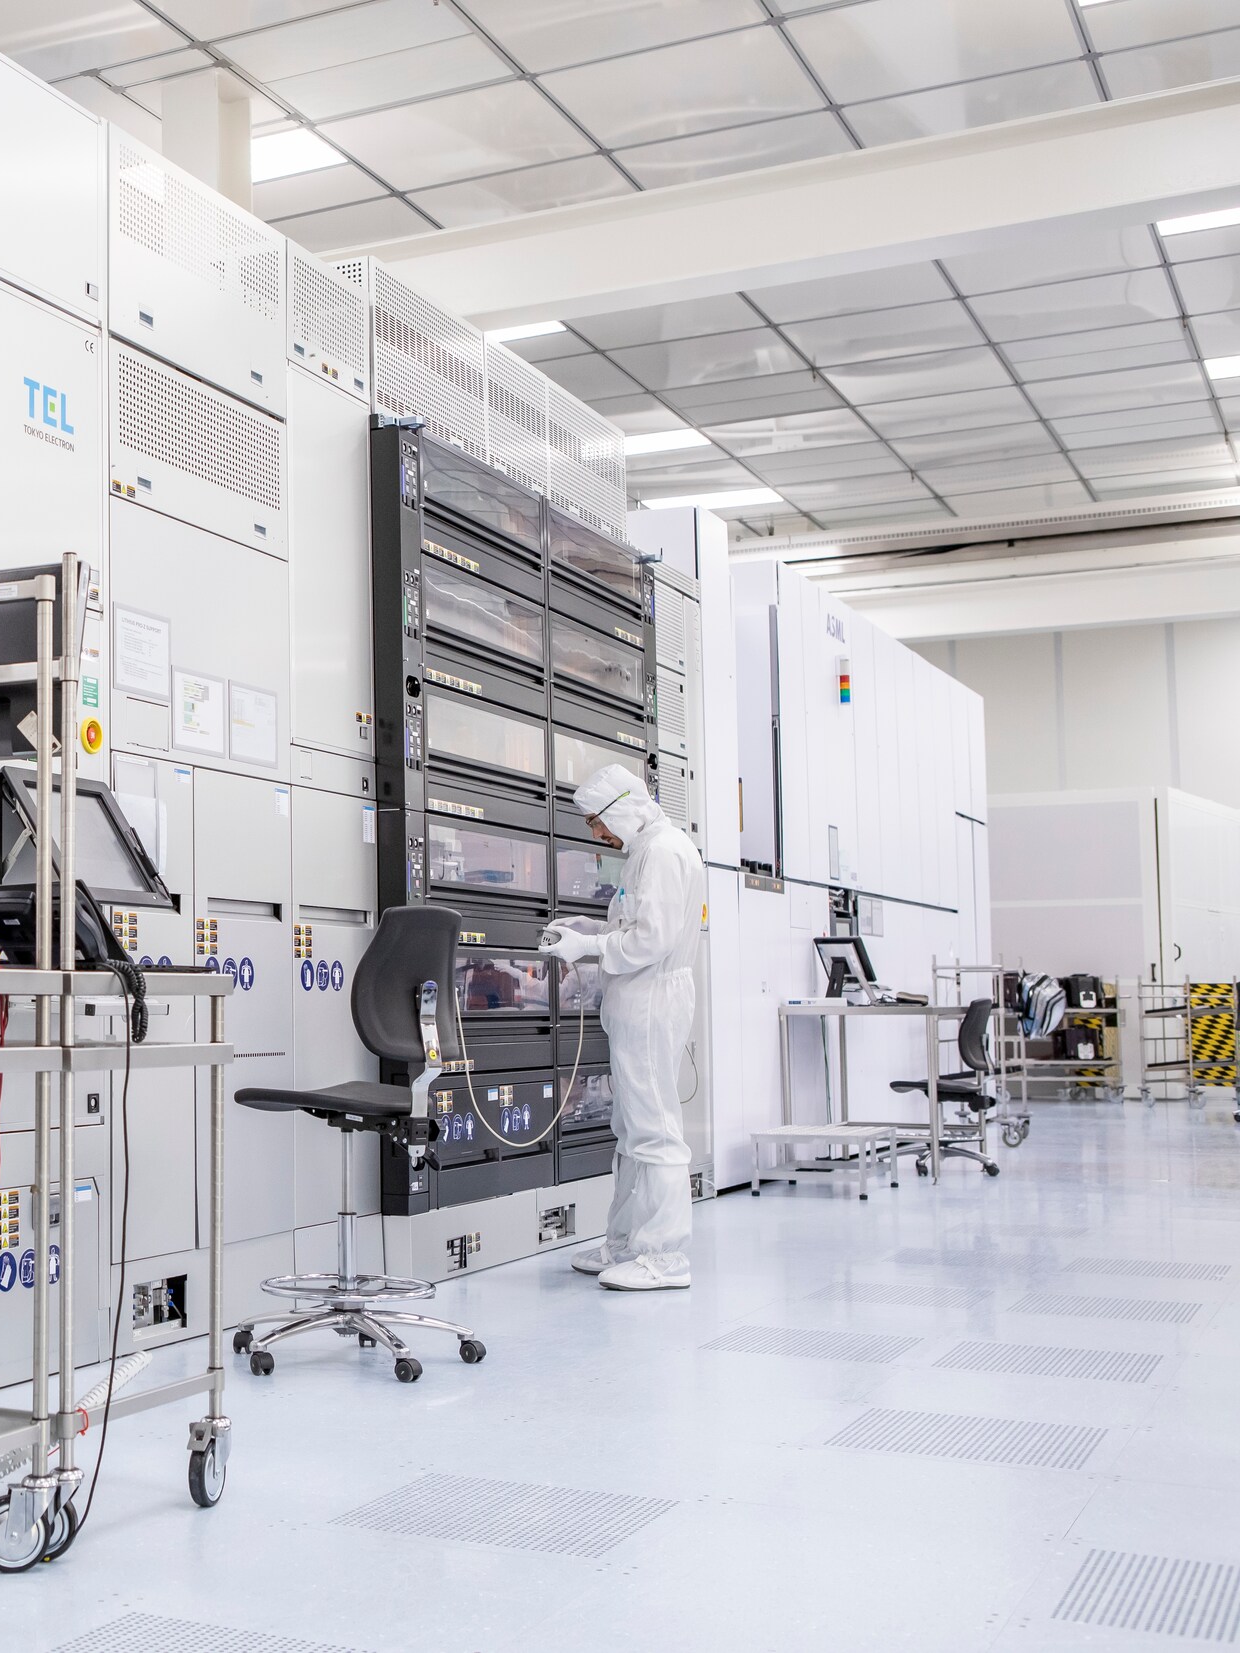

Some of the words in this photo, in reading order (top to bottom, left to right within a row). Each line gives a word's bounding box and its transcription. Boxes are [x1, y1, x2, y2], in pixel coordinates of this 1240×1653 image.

[24, 376, 74, 435] TEL
[24, 424, 44, 440] TOKYO
[45, 433, 75, 452] ELECTRON
[826, 612, 845, 644] ASML
